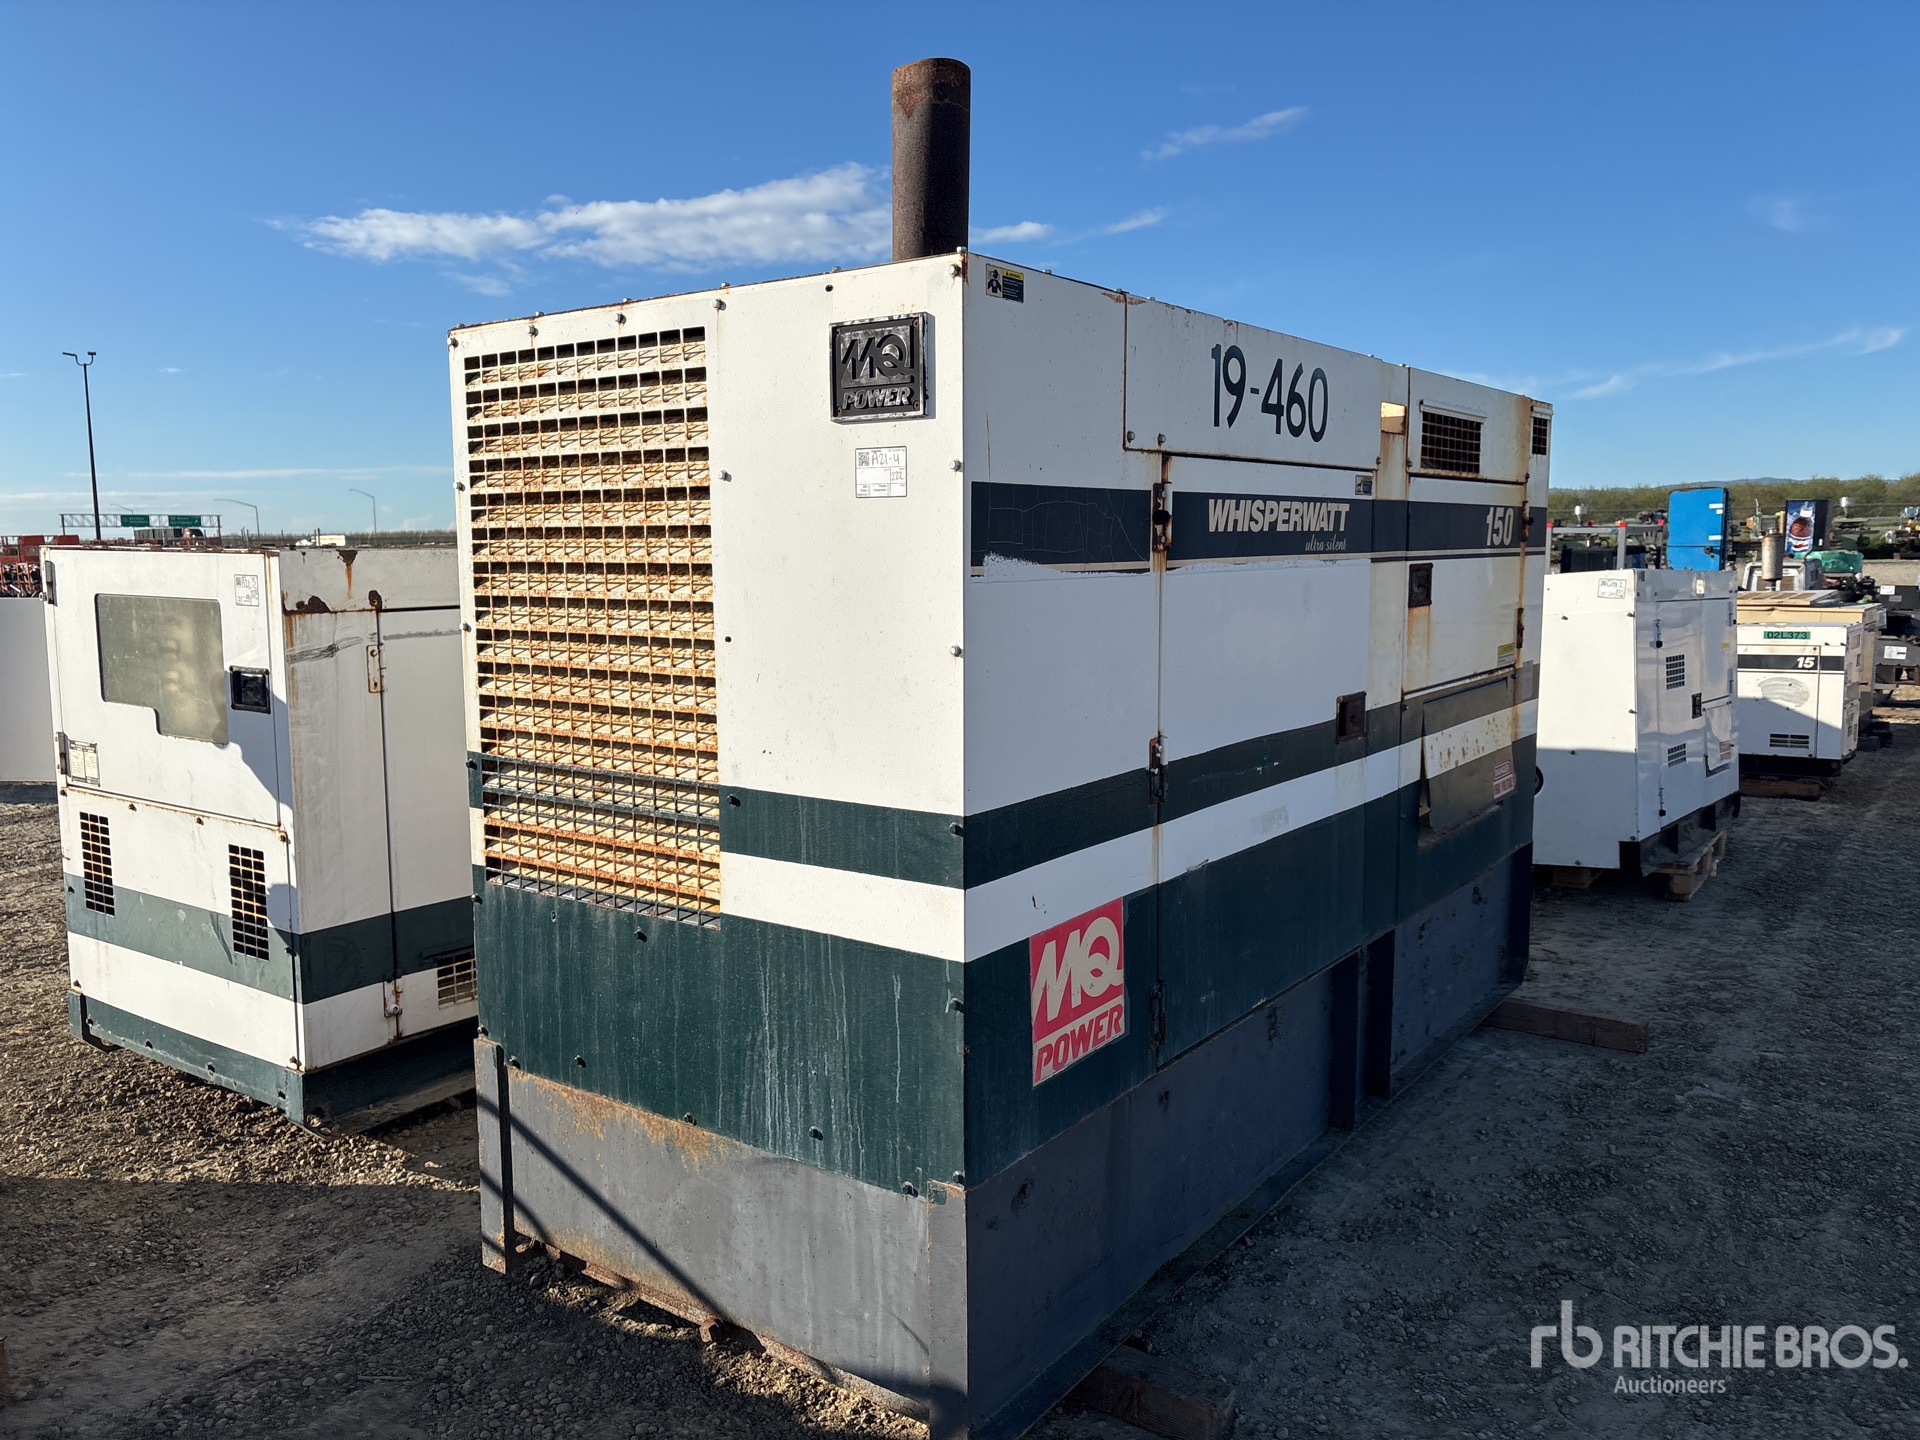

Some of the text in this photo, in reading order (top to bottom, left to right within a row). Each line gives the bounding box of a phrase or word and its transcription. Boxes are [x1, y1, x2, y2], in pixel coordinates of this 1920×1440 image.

[840, 333, 914, 383] MQ
[842, 387, 912, 410] POWER
[1211, 343, 1329, 443] 19-460
[1208, 499, 1350, 532] WHISPERWATT
[1486, 506, 1514, 546] 150
[1305, 533, 1347, 552] ultra silent
[1796, 656, 1816, 669] 15
[1031, 916, 1124, 1024] MQ
[1034, 1003, 1123, 1082] POWER
